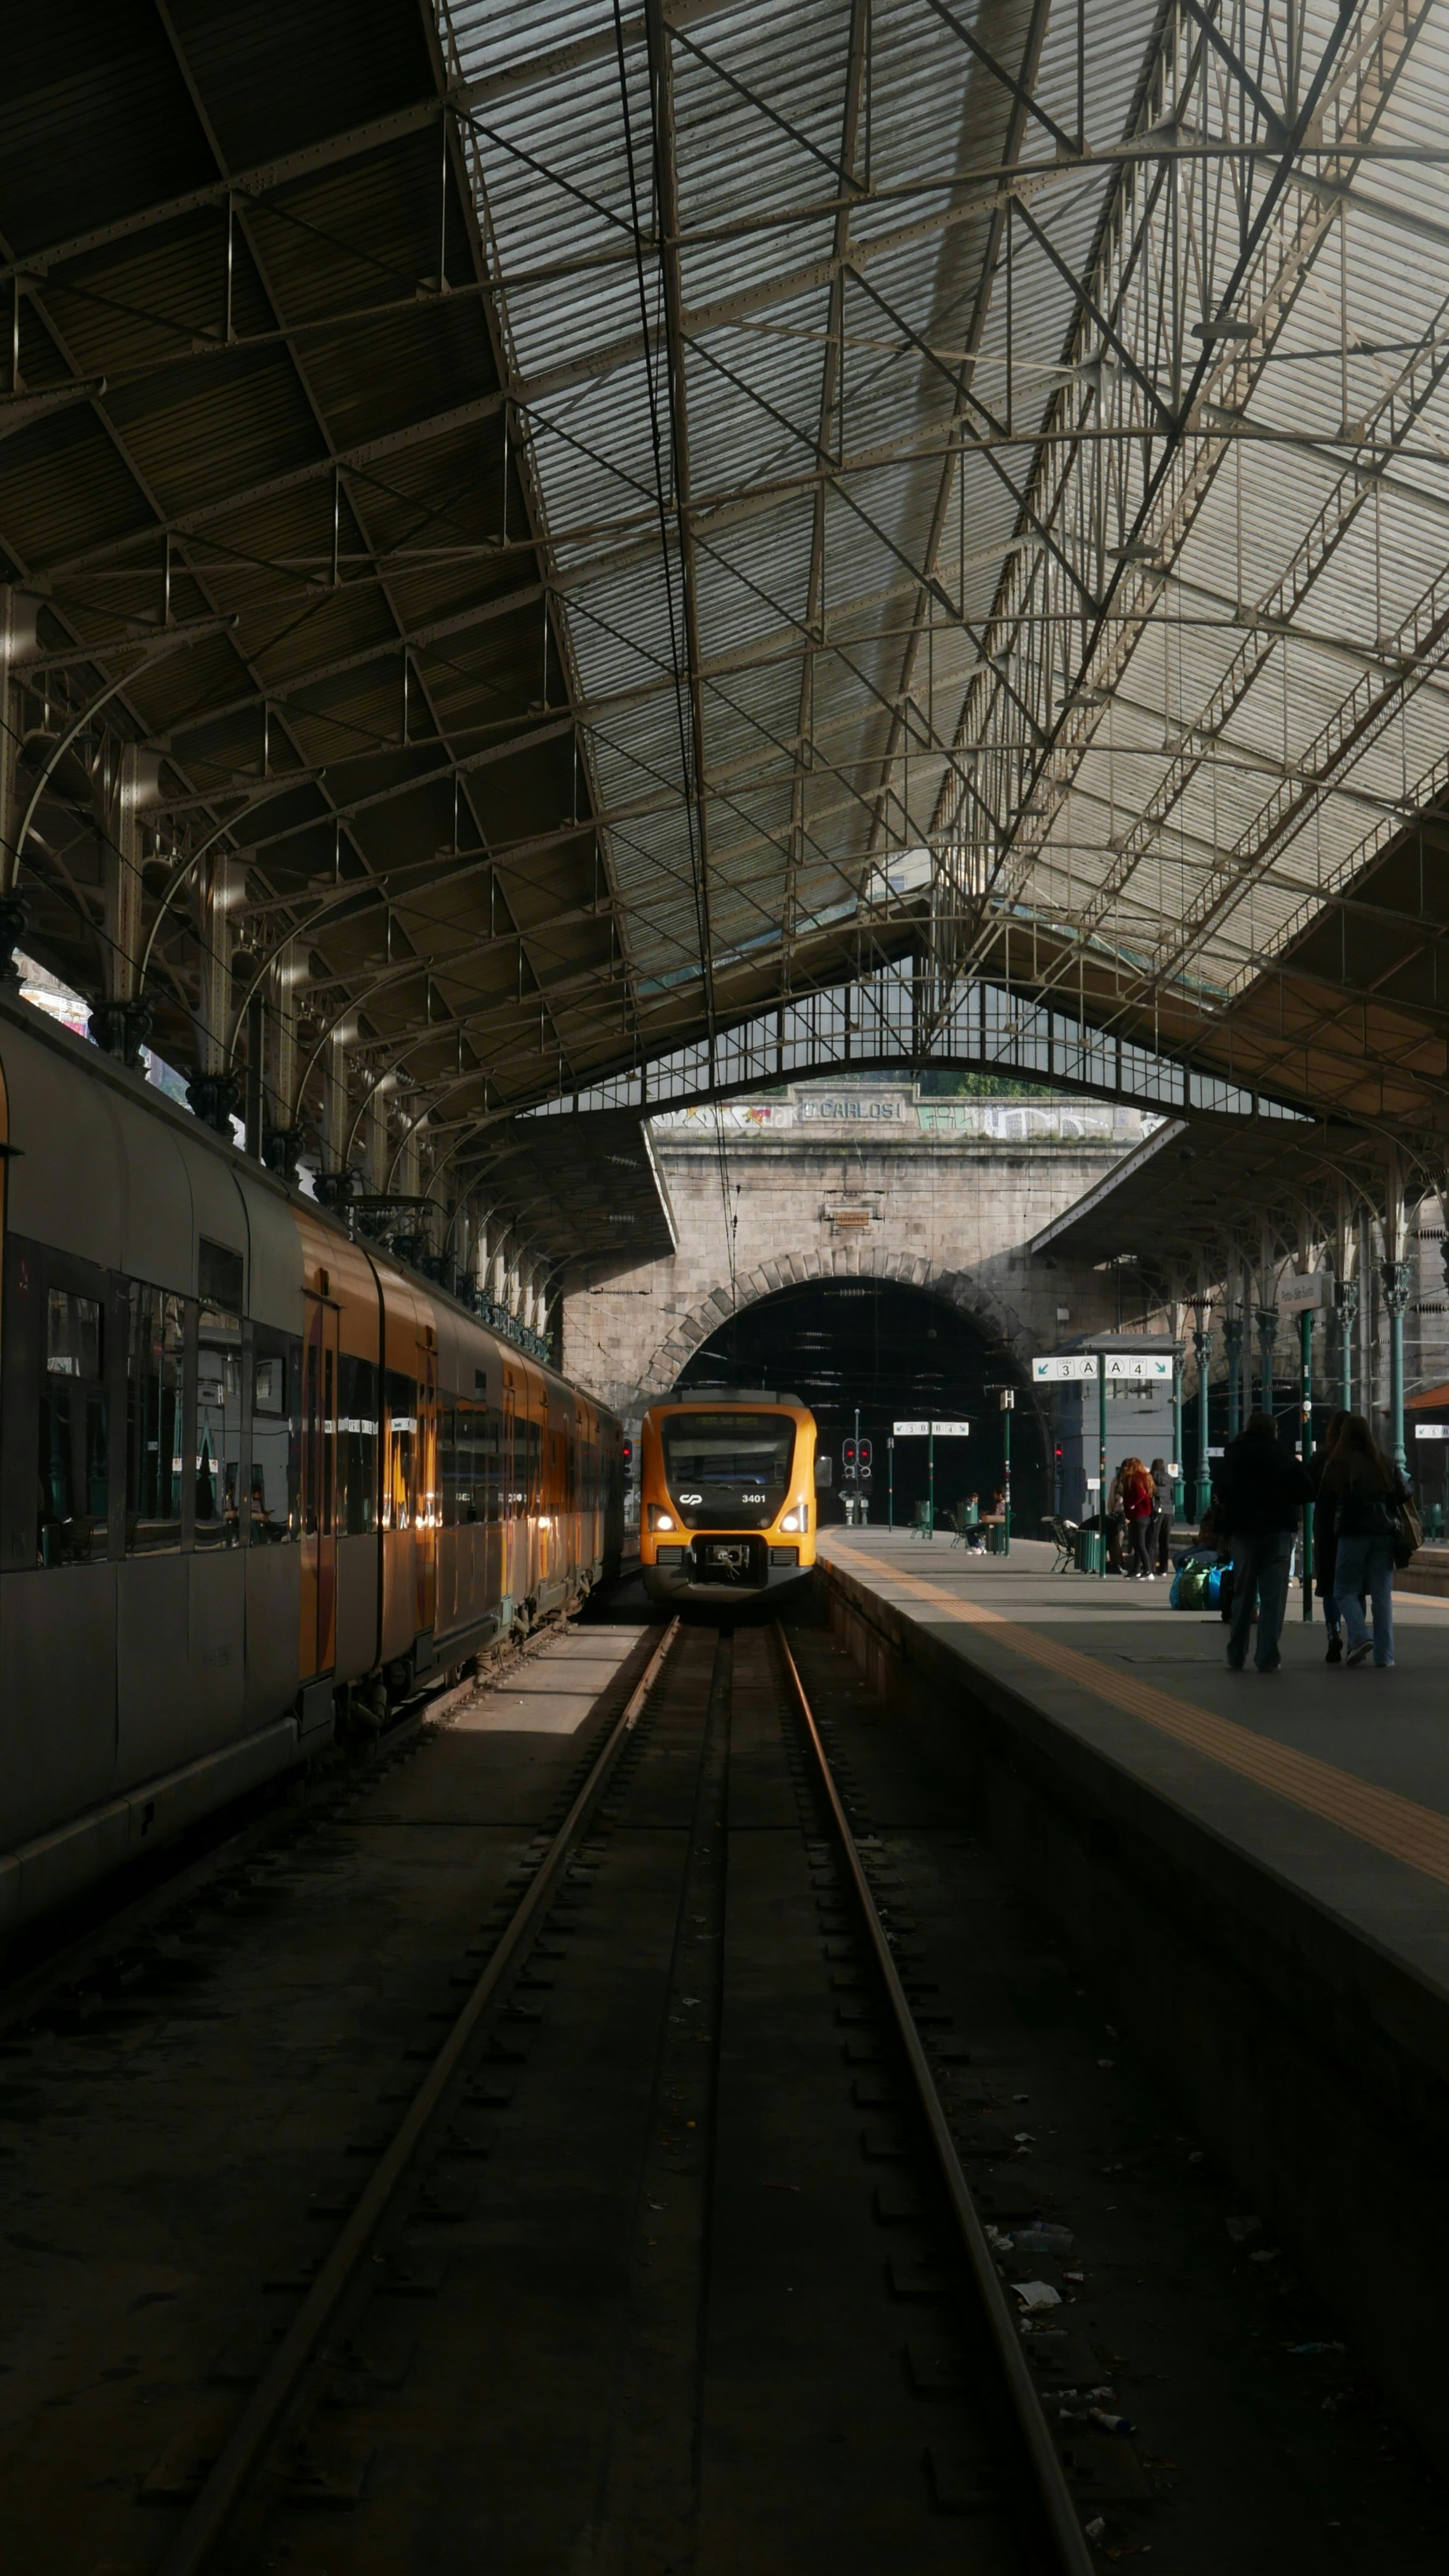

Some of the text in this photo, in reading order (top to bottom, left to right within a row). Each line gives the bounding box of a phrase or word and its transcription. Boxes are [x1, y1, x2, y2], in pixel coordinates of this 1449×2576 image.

[821, 1102, 894, 1118] CARLOS
[1063, 1362, 1093, 1376] 3 A
[1112, 1362, 1142, 1374] A 4
[742, 1495, 765, 1503] 3401
